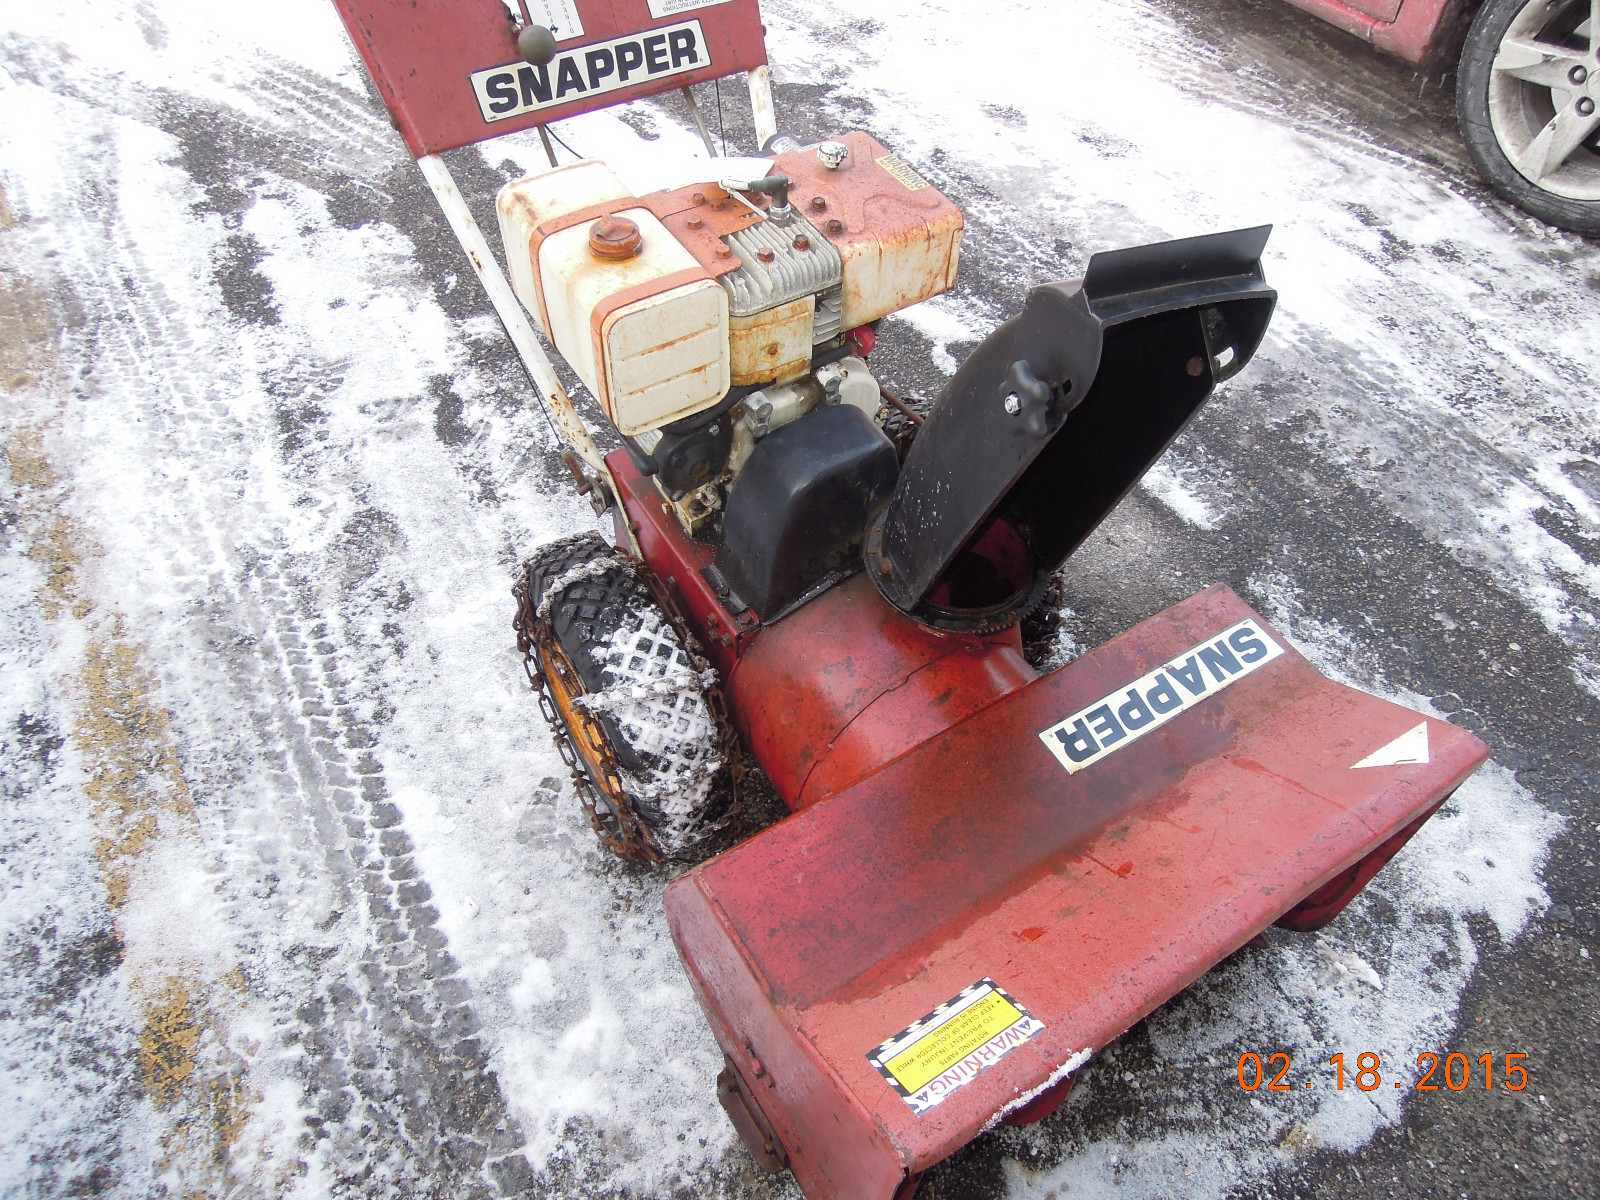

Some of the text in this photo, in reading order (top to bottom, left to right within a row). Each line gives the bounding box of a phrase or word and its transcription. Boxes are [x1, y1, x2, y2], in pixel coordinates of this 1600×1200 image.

[662, 0, 700, 12] INSTRUCTIONS
[485, 27, 698, 114] SNAPPER
[883, 155, 928, 188] WARNING
[1054, 627, 1268, 762] SNAPPER
[967, 998, 989, 1014] ENGINE
[980, 1004, 995, 1016] KEEP
[932, 1018, 960, 1038] RUNNING
[961, 1014, 979, 1029] CLEAR
[983, 1015, 995, 1024] TO
[949, 1024, 983, 1048] PREVENT
[952, 1027, 960, 1035] OF
[916, 1033, 950, 1058] COLLECTOR
[939, 1031, 989, 1066] ROTATING PARTS
[895, 1057, 916, 1073] WHILE
[921, 1046, 948, 1068] INJURY
[928, 1026, 1025, 1095] WARNING
